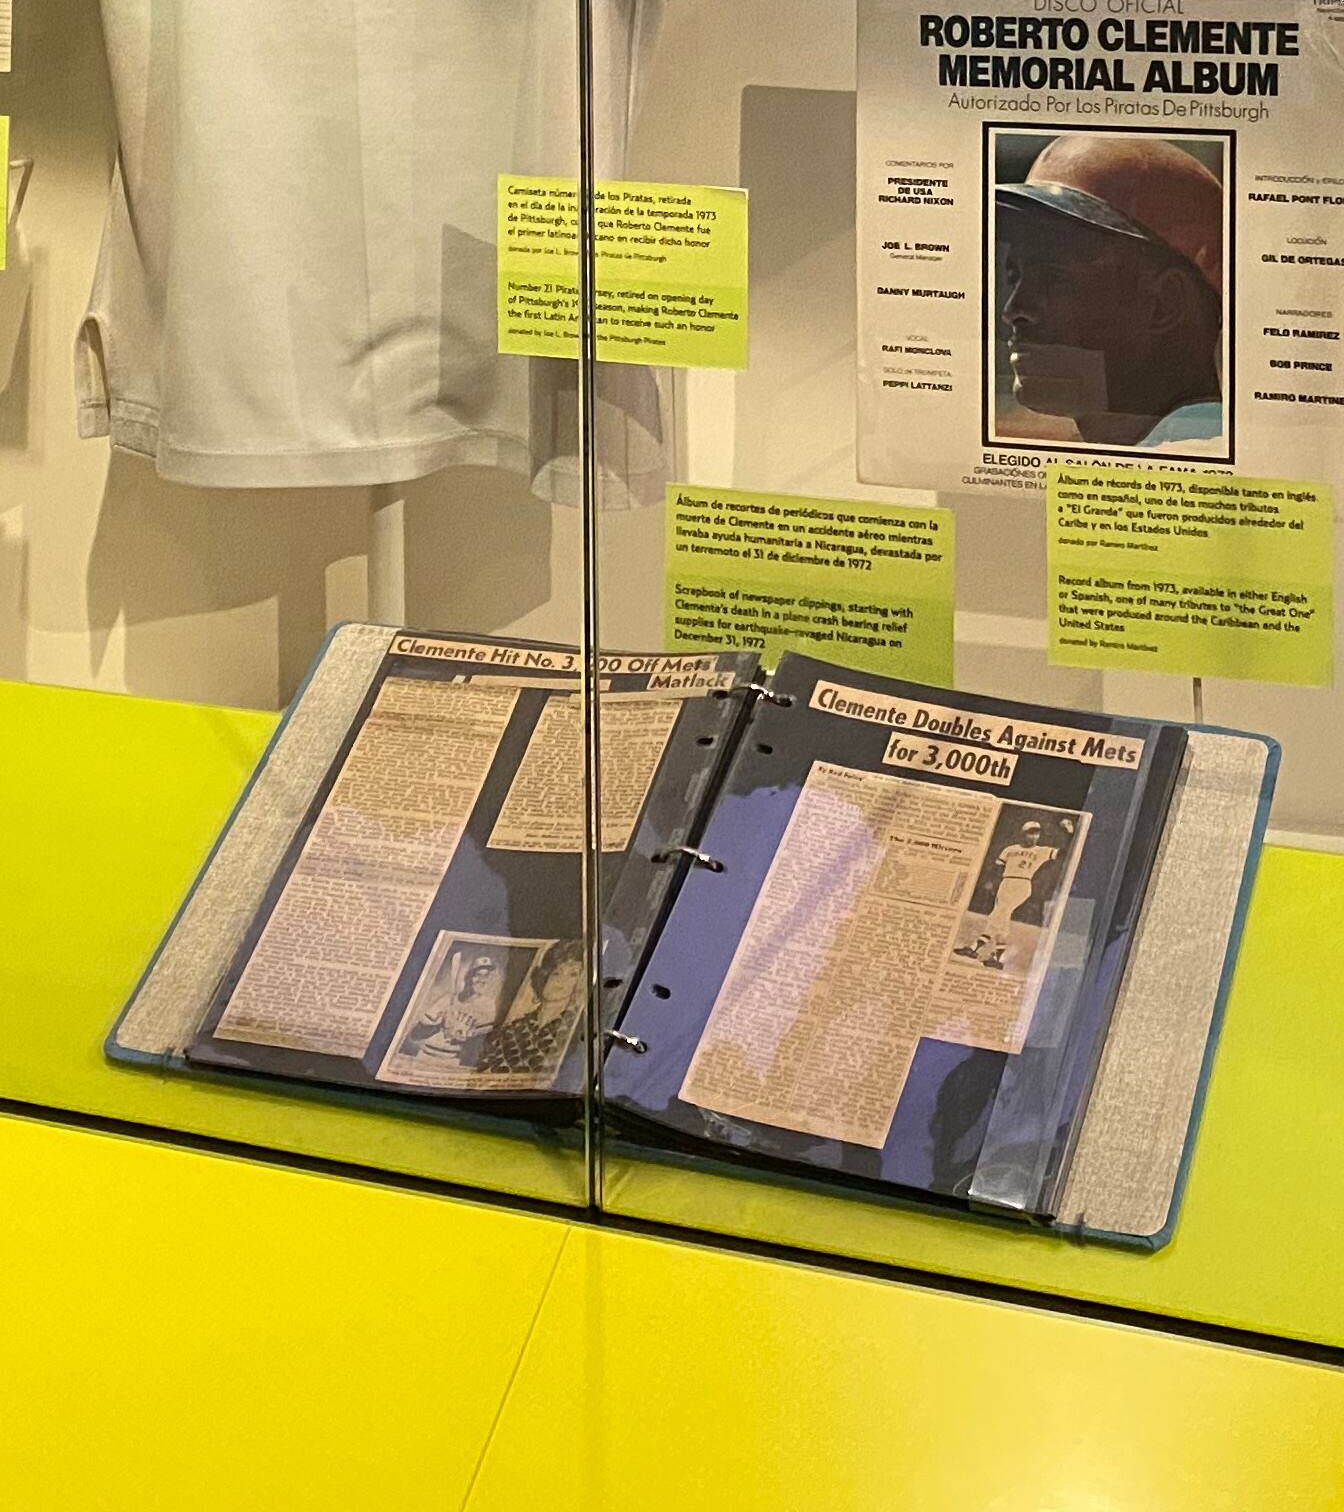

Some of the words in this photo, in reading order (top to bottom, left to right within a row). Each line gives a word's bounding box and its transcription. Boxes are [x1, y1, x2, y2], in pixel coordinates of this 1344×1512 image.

[919, 13, 1090, 50] ROBERTO
[1096, 18, 1300, 56] CLEMENTE
[937, 53, 1136, 93] MEMORIAL
[1141, 59, 1279, 96] ALBUM
[946, 91, 1043, 112] Autorizado
[1045, 94, 1072, 113] Por
[1075, 96, 1101, 114] Los
[1103, 96, 1160, 116] Piratas
[1161, 97, 1187, 117] De
[1188, 98, 1273, 123] Pittsburgh
[877, 193, 922, 205] RICHARD
[922, 196, 954, 206] NIXON
[1247, 191, 1290, 203] RAFAEL
[1290, 193, 1321, 204] PONT
[1260, 253, 1279, 263] GIL
[1279, 253, 1296, 264] DE
[1262, 326, 1291, 337] FELO
[1291, 328, 1340, 340] RAMIREZ
[1268, 358, 1292, 369] BOB
[1292, 360, 1333, 372] PRINCE
[1253, 390, 1297, 402] RAMIRO
[983, 452, 1042, 468] ELEGIDO
[396, 638, 487, 662] Clemente
[490, 649, 521, 666] Hit
[526, 652, 556, 669] No.
[561, 656, 621, 673] 3,00
[627, 657, 660, 672] Off
[650, 672, 729, 689] Matlack
[817, 688, 907, 724] Clemente
[913, 709, 991, 742] Doubles
[997, 726, 1076, 755] Against
[1081, 738, 1137, 764] Mets
[888, 739, 919, 762] for
[927, 745, 1011, 779] 3,000th
